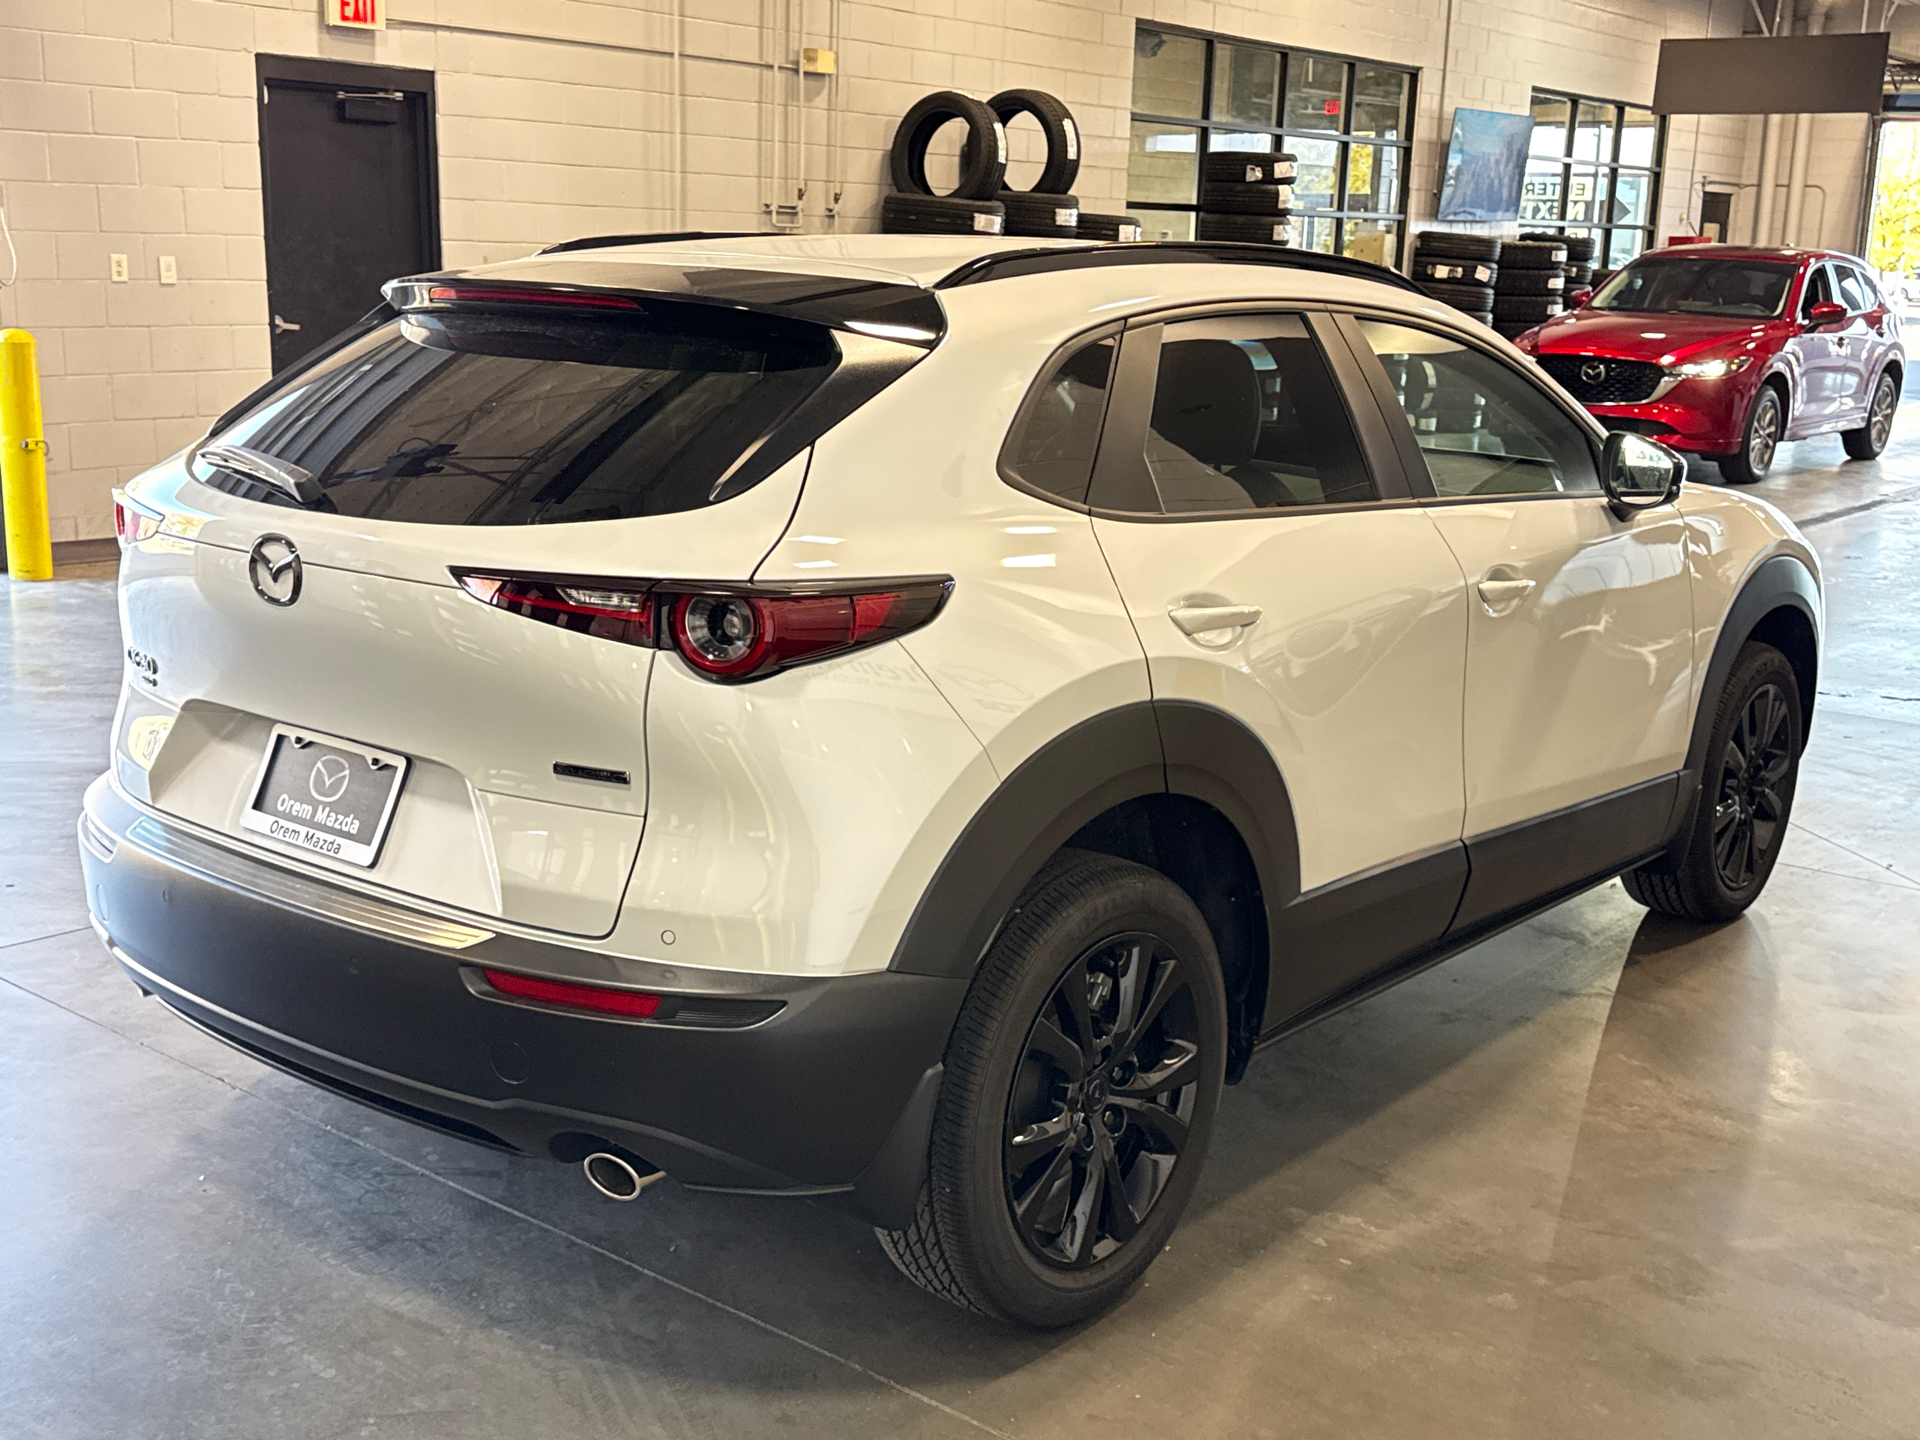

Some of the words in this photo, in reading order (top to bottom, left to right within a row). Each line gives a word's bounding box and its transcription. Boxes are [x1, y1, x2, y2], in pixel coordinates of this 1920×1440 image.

[276, 793, 313, 821] Orem
[314, 804, 361, 835] Mazda
[269, 819, 300, 843] Orem
[302, 830, 342, 855] Mazda
